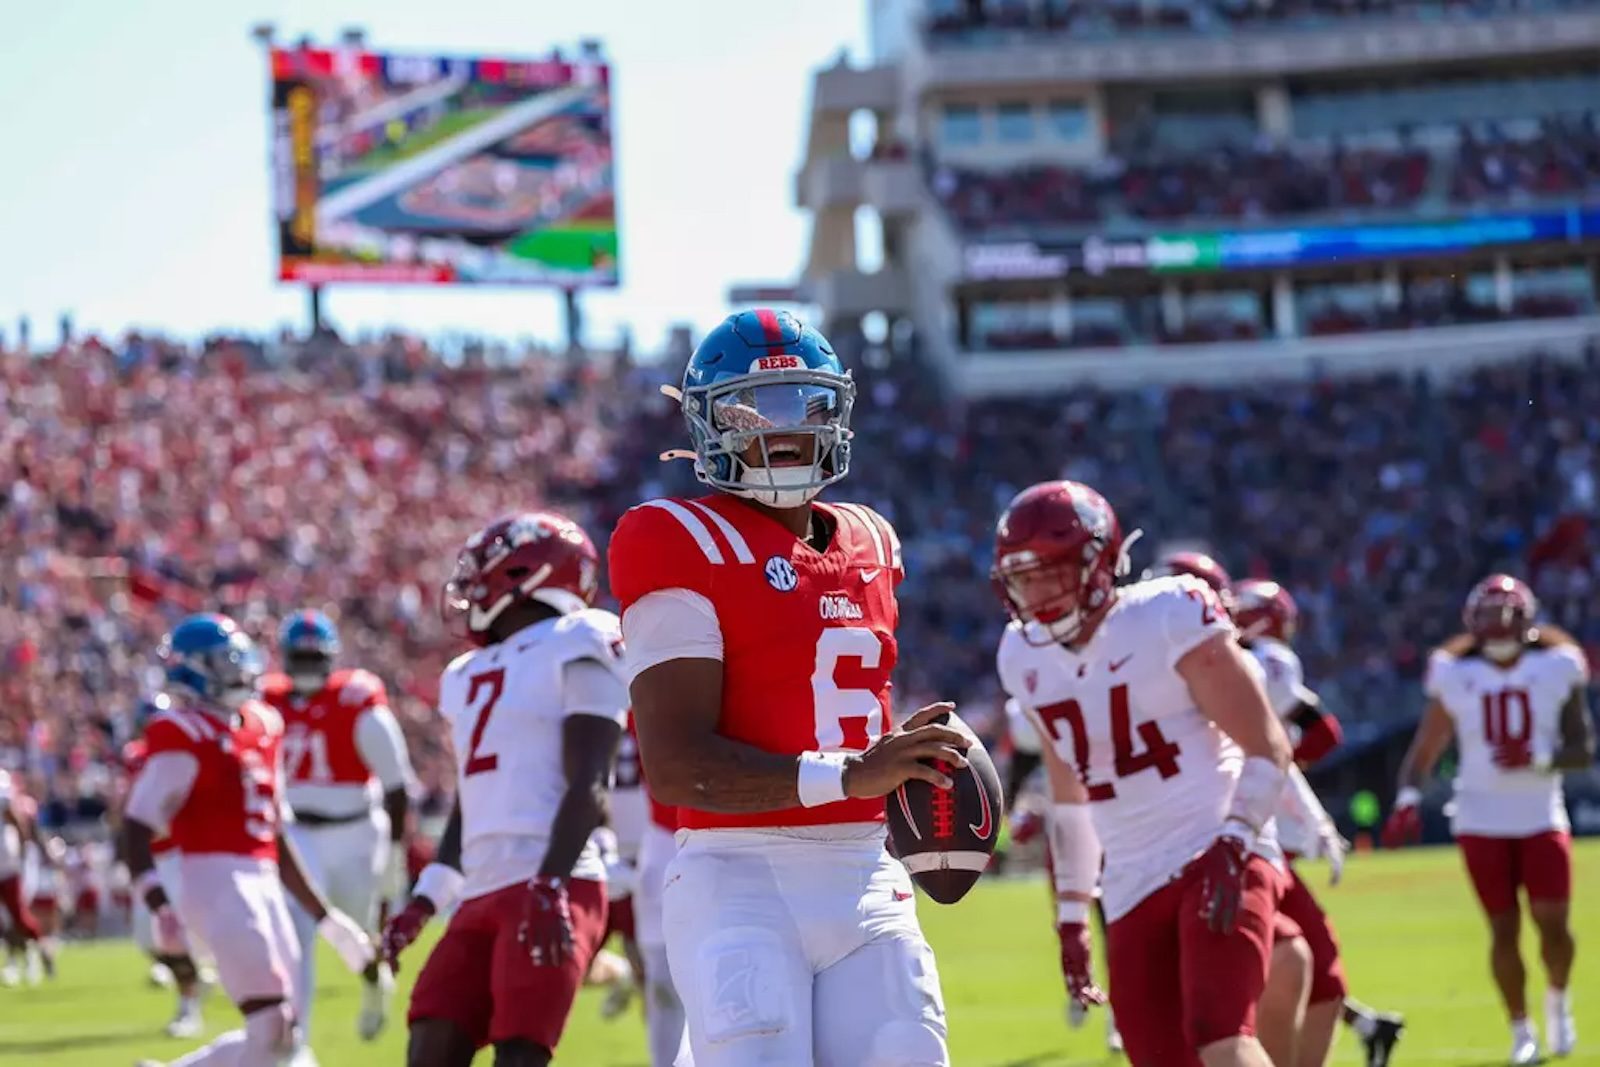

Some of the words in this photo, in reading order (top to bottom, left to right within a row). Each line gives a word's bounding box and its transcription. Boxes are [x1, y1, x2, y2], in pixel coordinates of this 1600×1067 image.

[757, 356, 799, 371] REBS
[766, 556, 797, 591] SEC
[466, 666, 506, 777] 2
[811, 627, 882, 752] 6
[1480, 687, 1533, 757] 10
[1037, 684, 1182, 802] 24
